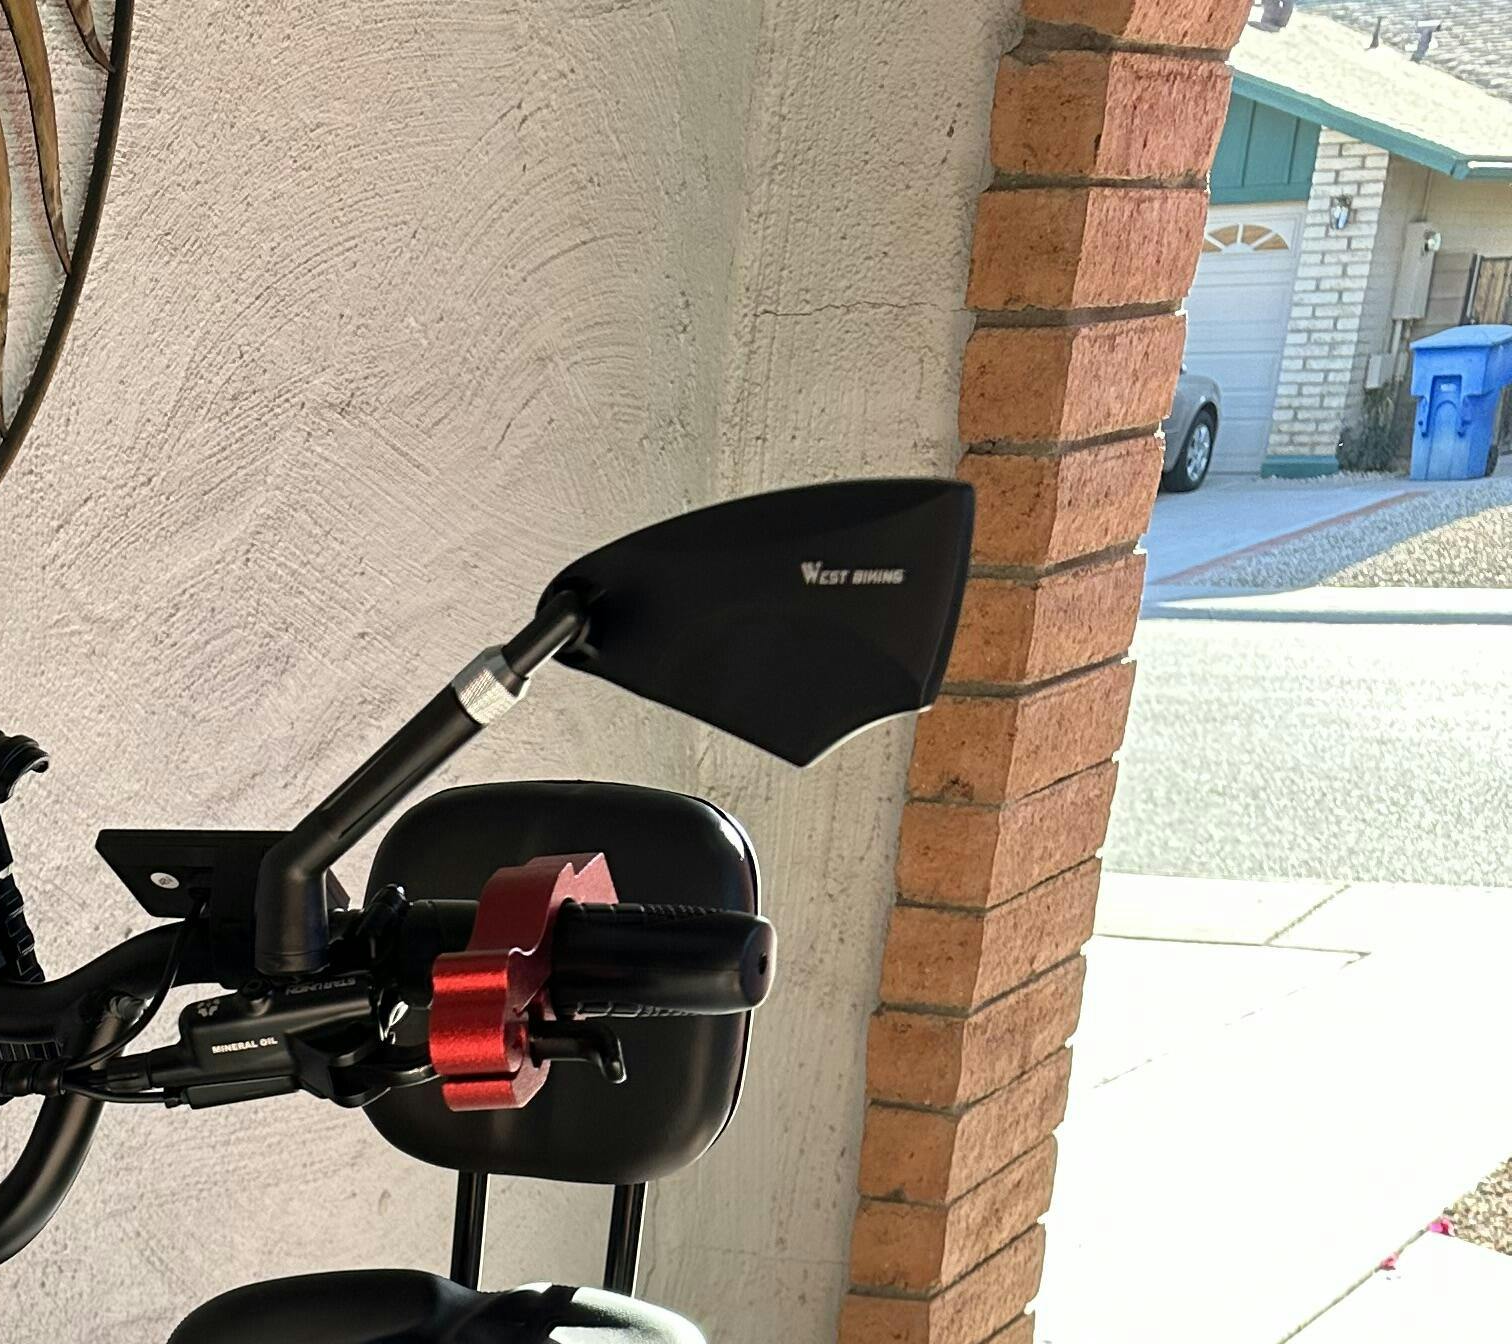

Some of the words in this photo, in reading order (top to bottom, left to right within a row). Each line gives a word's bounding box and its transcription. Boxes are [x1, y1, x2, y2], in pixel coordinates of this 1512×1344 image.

[801, 561, 850, 585] WEST
[852, 568, 904, 585] BIKING
[212, 1040, 258, 1054] MINERAL
[259, 1036, 278, 1048] OIL
